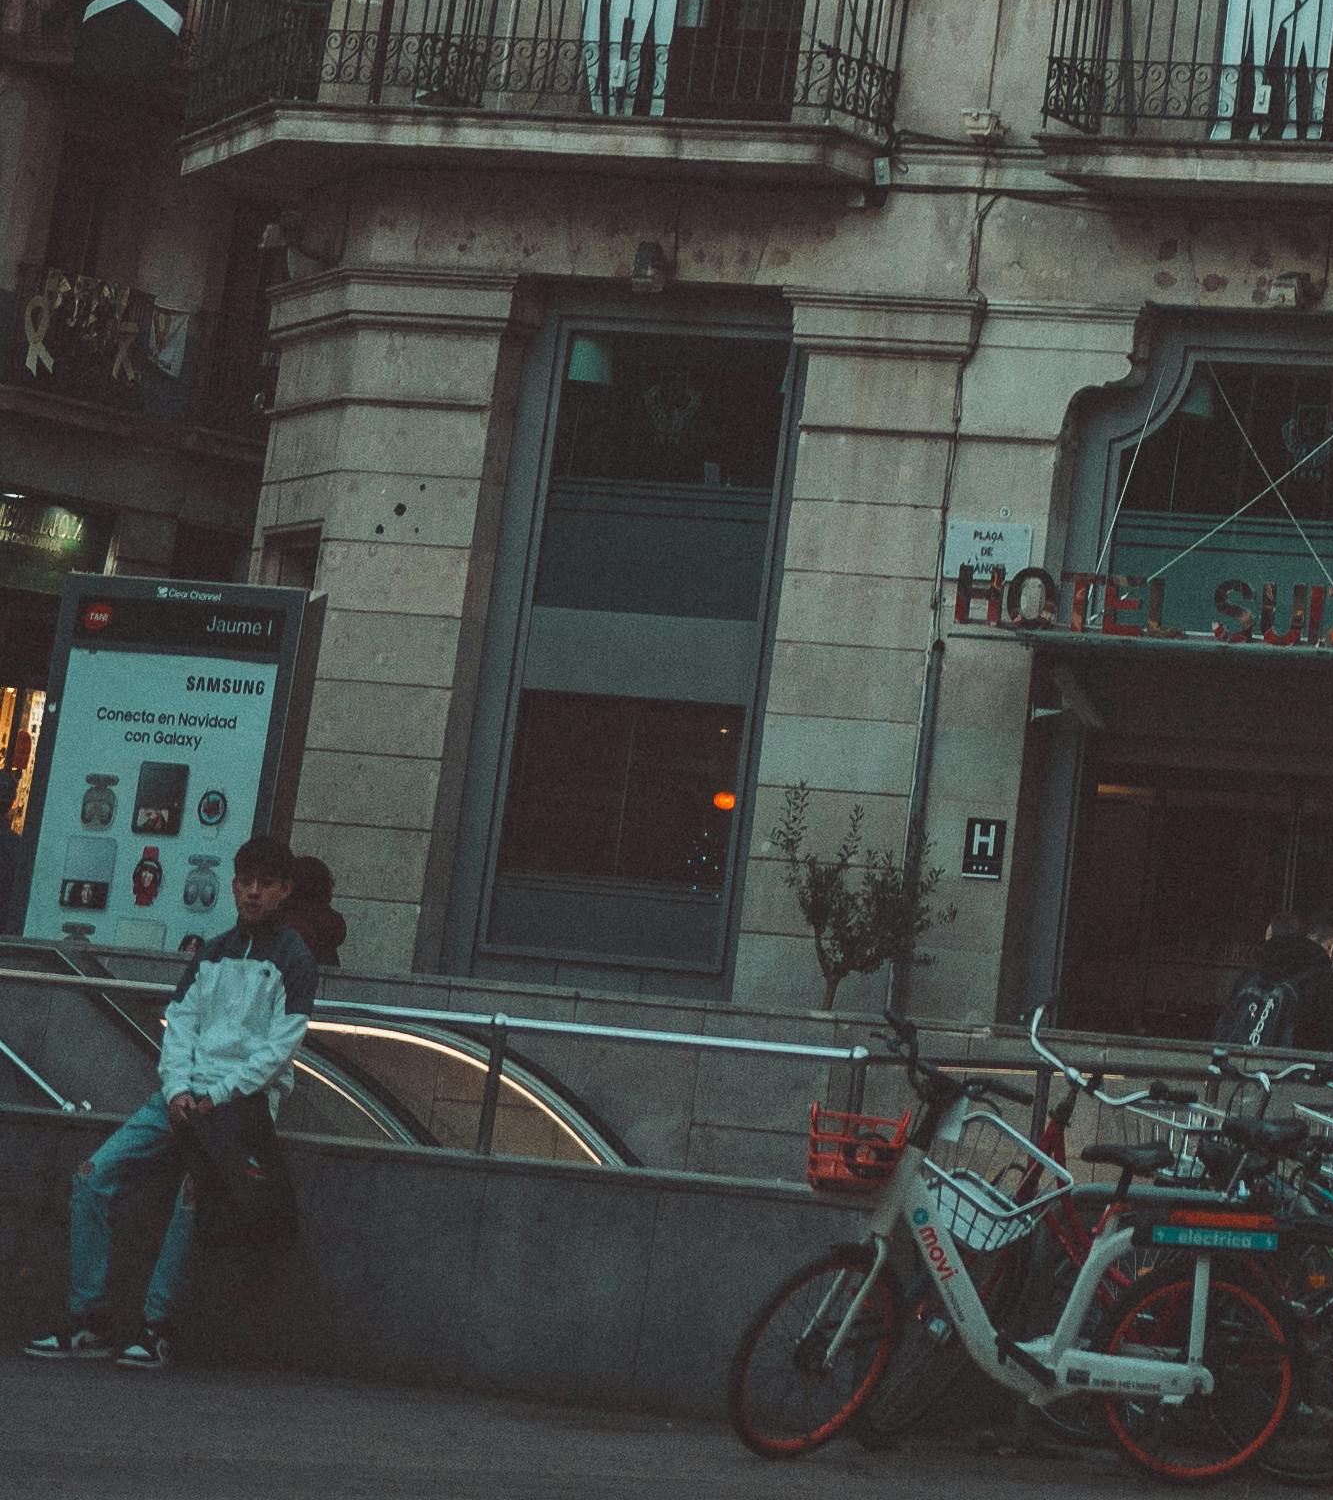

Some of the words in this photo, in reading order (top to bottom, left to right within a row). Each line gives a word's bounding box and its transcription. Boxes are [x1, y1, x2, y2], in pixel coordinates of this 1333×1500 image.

[973, 530, 1005, 544] PLAÇA
[980, 547, 994, 558] DE
[168, 587, 189, 599] Clear
[190, 591, 222, 602] Channel
[954, 565, 1185, 637] HOTEL
[206, 616, 262, 636] Jaume
[186, 675, 266, 696] SAMSUNG
[96, 706, 154, 724] Conecta
[158, 713, 175, 726] en
[178, 712, 237, 730] Navidad
[124, 731, 150, 744] con
[153, 731, 202, 750] Galaxy
[972, 823, 996, 857] H
[919, 1226, 960, 1281] movi
